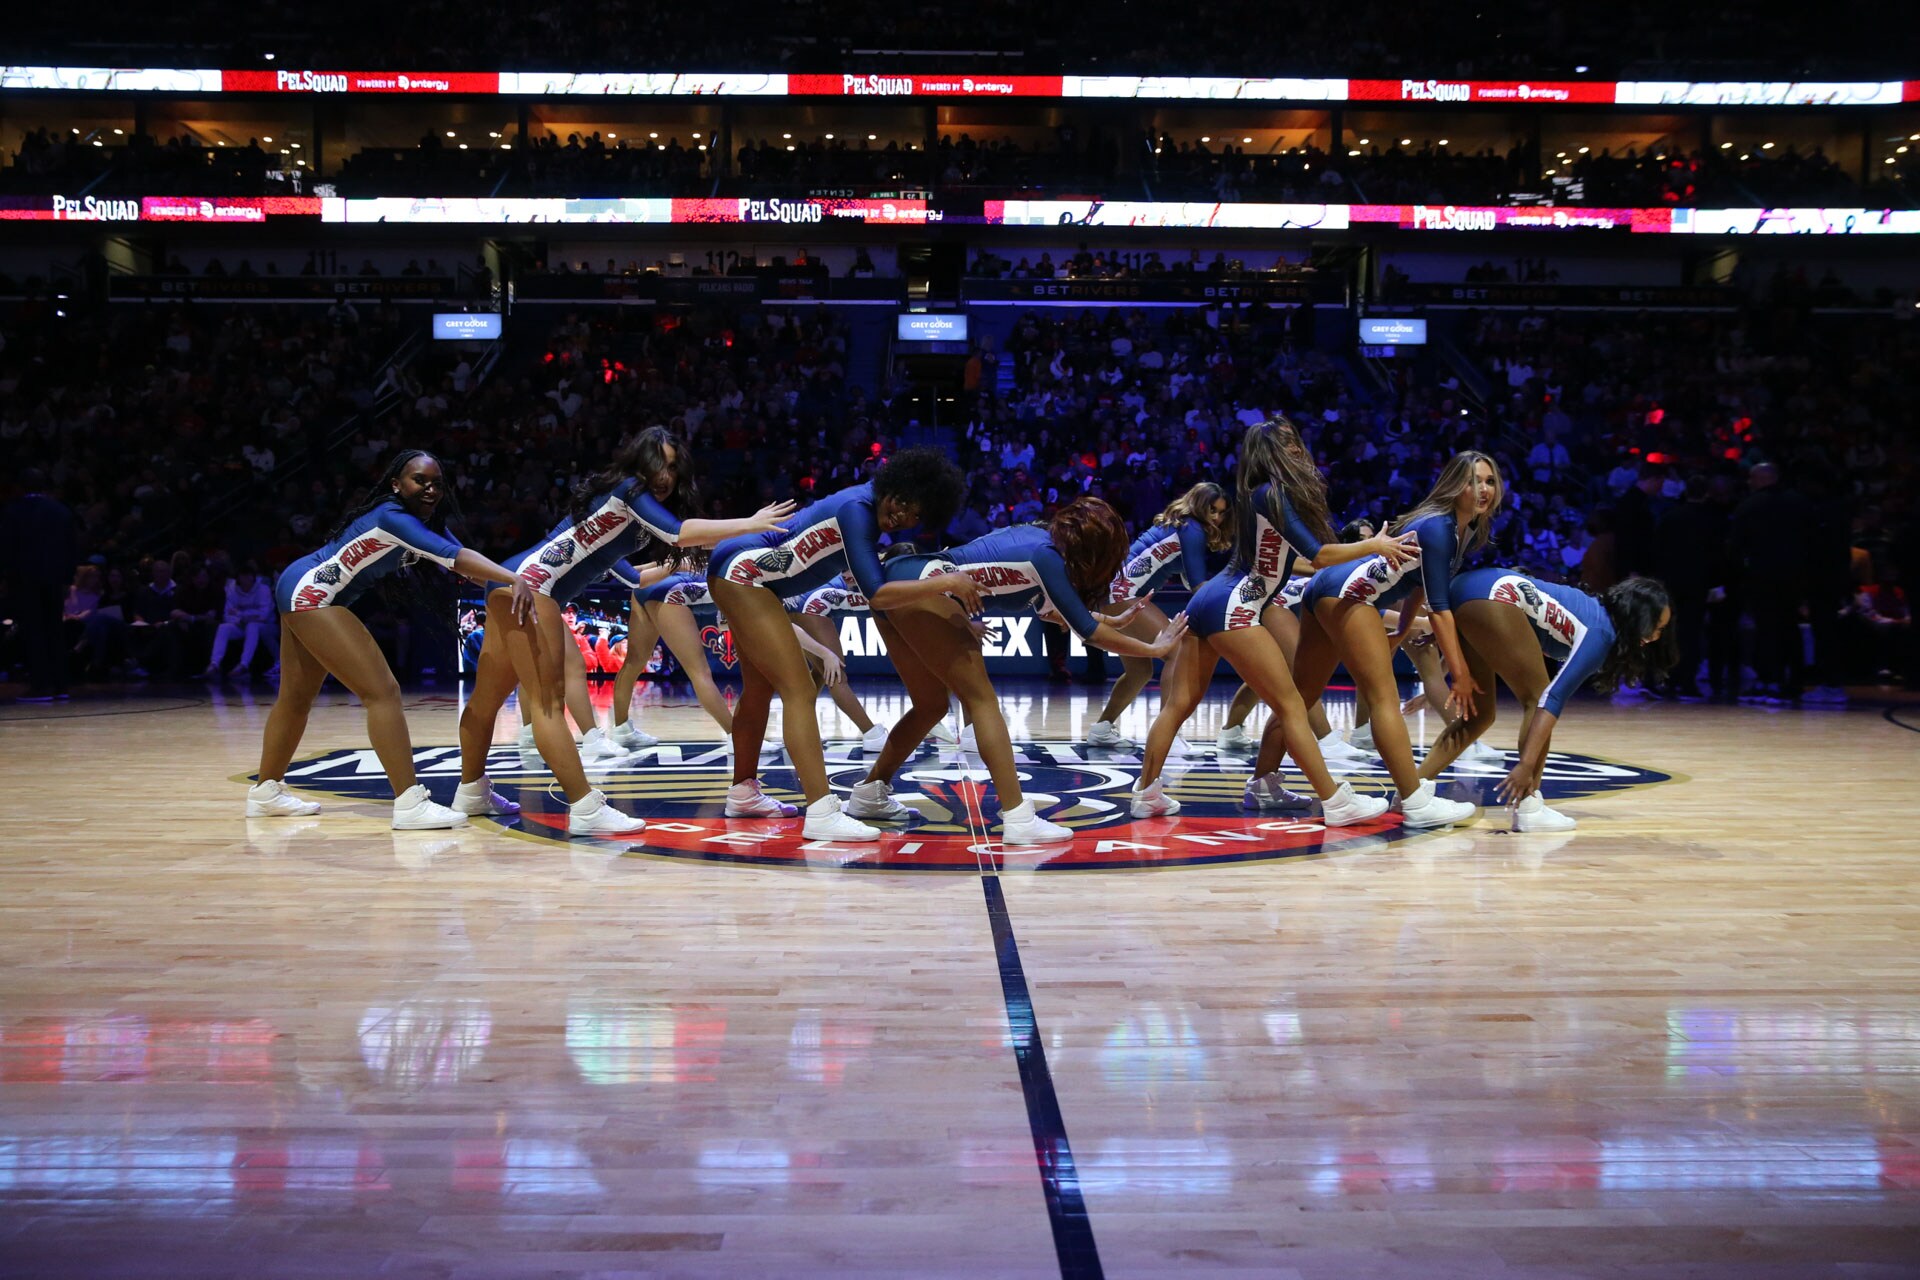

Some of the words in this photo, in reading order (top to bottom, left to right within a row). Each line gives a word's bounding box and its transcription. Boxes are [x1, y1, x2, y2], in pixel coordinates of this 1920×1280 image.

[357, 80, 386, 88] POWERED
[388, 80, 396, 88] BY
[411, 80, 449, 90] entergy
[922, 82, 950, 91] POWERED
[952, 82, 960, 91] BY
[975, 82, 1013, 93] entergy
[1530, 89, 1569, 100] entergy
[215, 207, 262, 219] entergy
[897, 209, 943, 221] entergy
[572, 511, 627, 549] PELICANS
[793, 526, 842, 564] PELICANS
[339, 537, 392, 572] PELICANS
